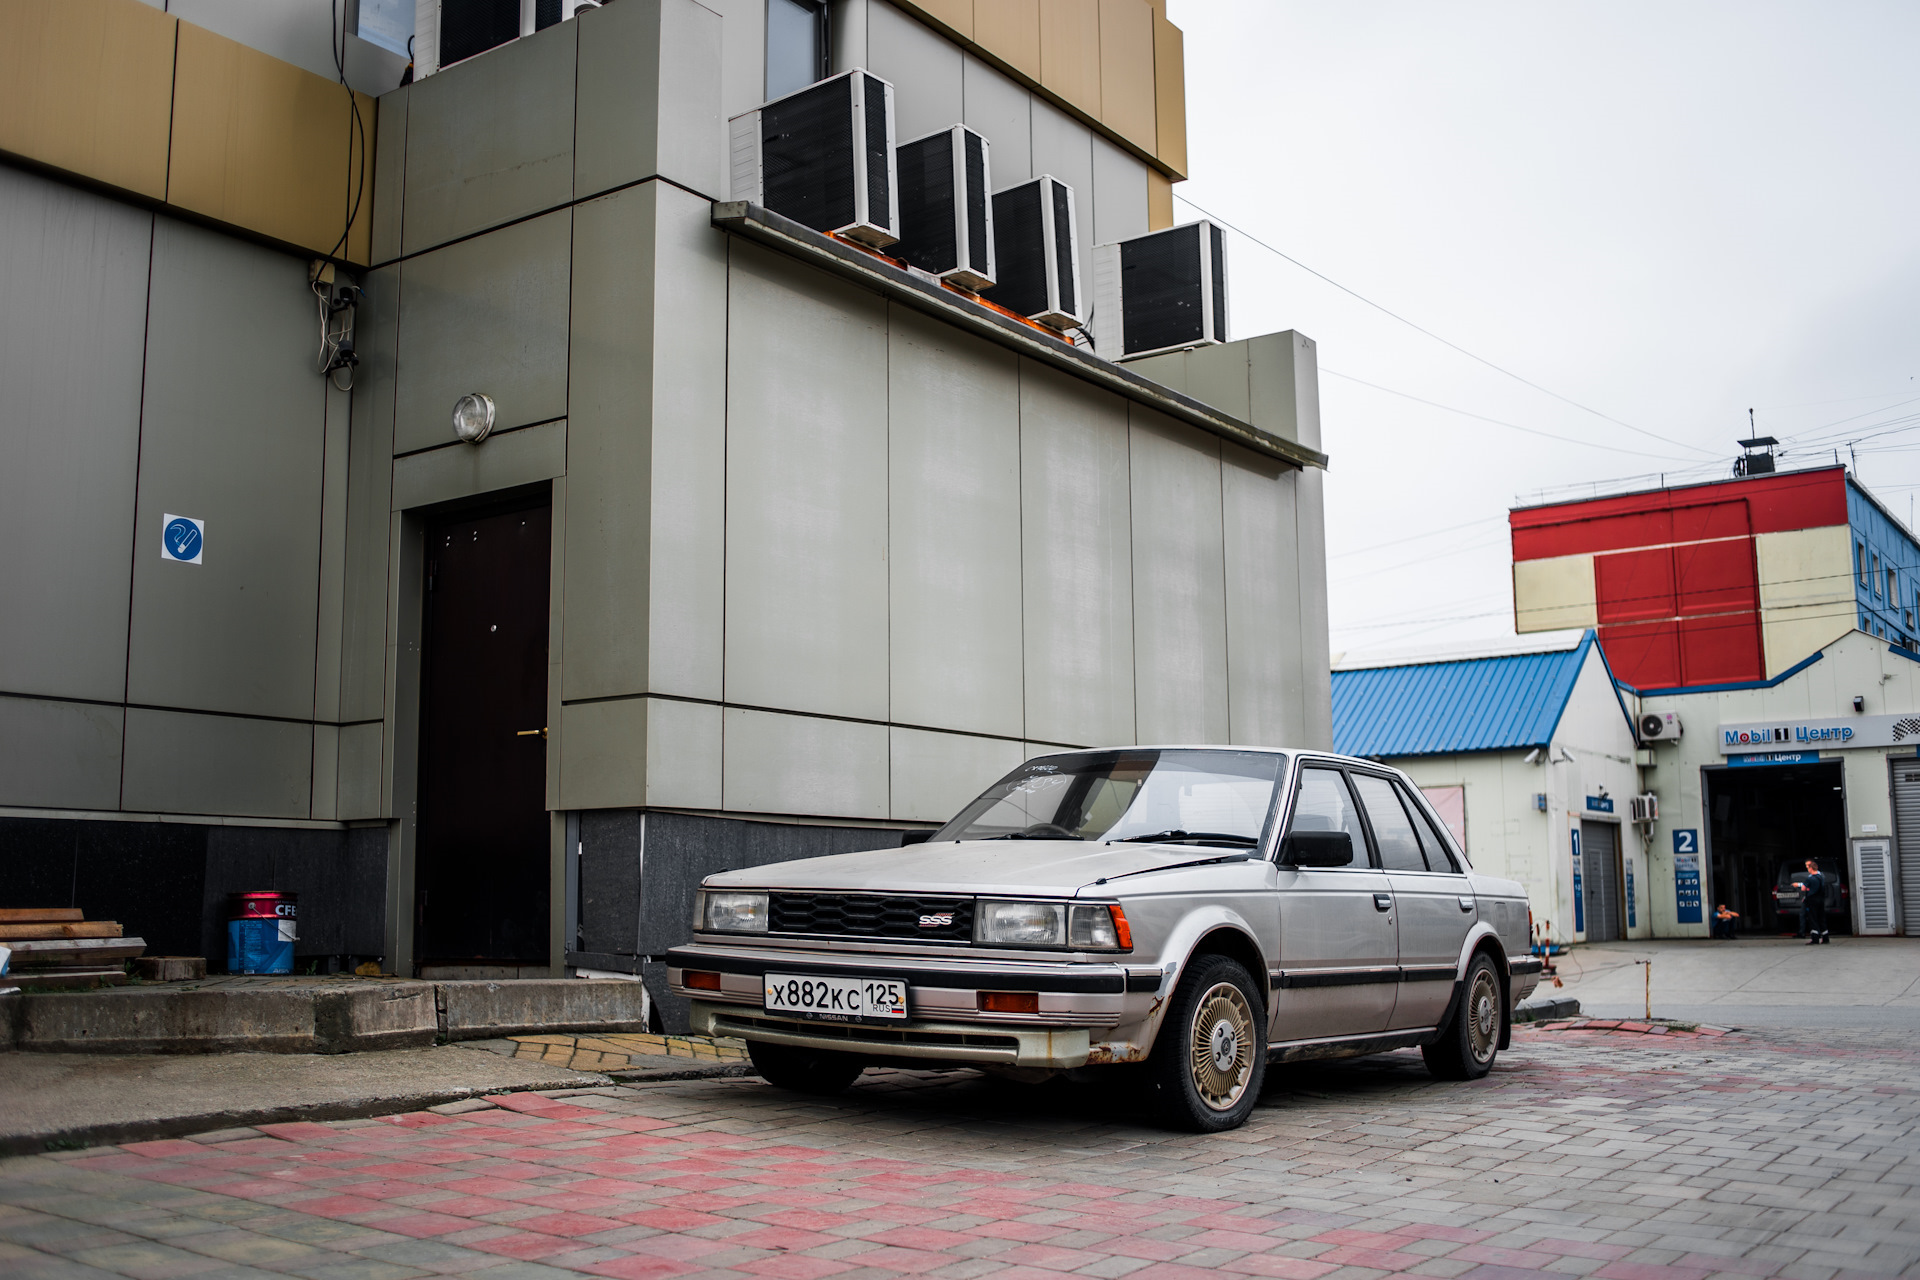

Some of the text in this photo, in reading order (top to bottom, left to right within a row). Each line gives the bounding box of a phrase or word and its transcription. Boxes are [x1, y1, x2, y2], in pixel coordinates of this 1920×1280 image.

[1725, 729, 1771, 744] Mobil
[1795, 726, 1853, 742] Центр
[1774, 753, 1802, 762] Центр
[1573, 831, 1579, 855] 1
[1678, 831, 1693, 852] 2
[919, 914, 952, 926] SSS
[865, 983, 899, 1005] 125
[873, 1004, 891, 1013] RUS
[819, 1013, 849, 1022] NISSAN
